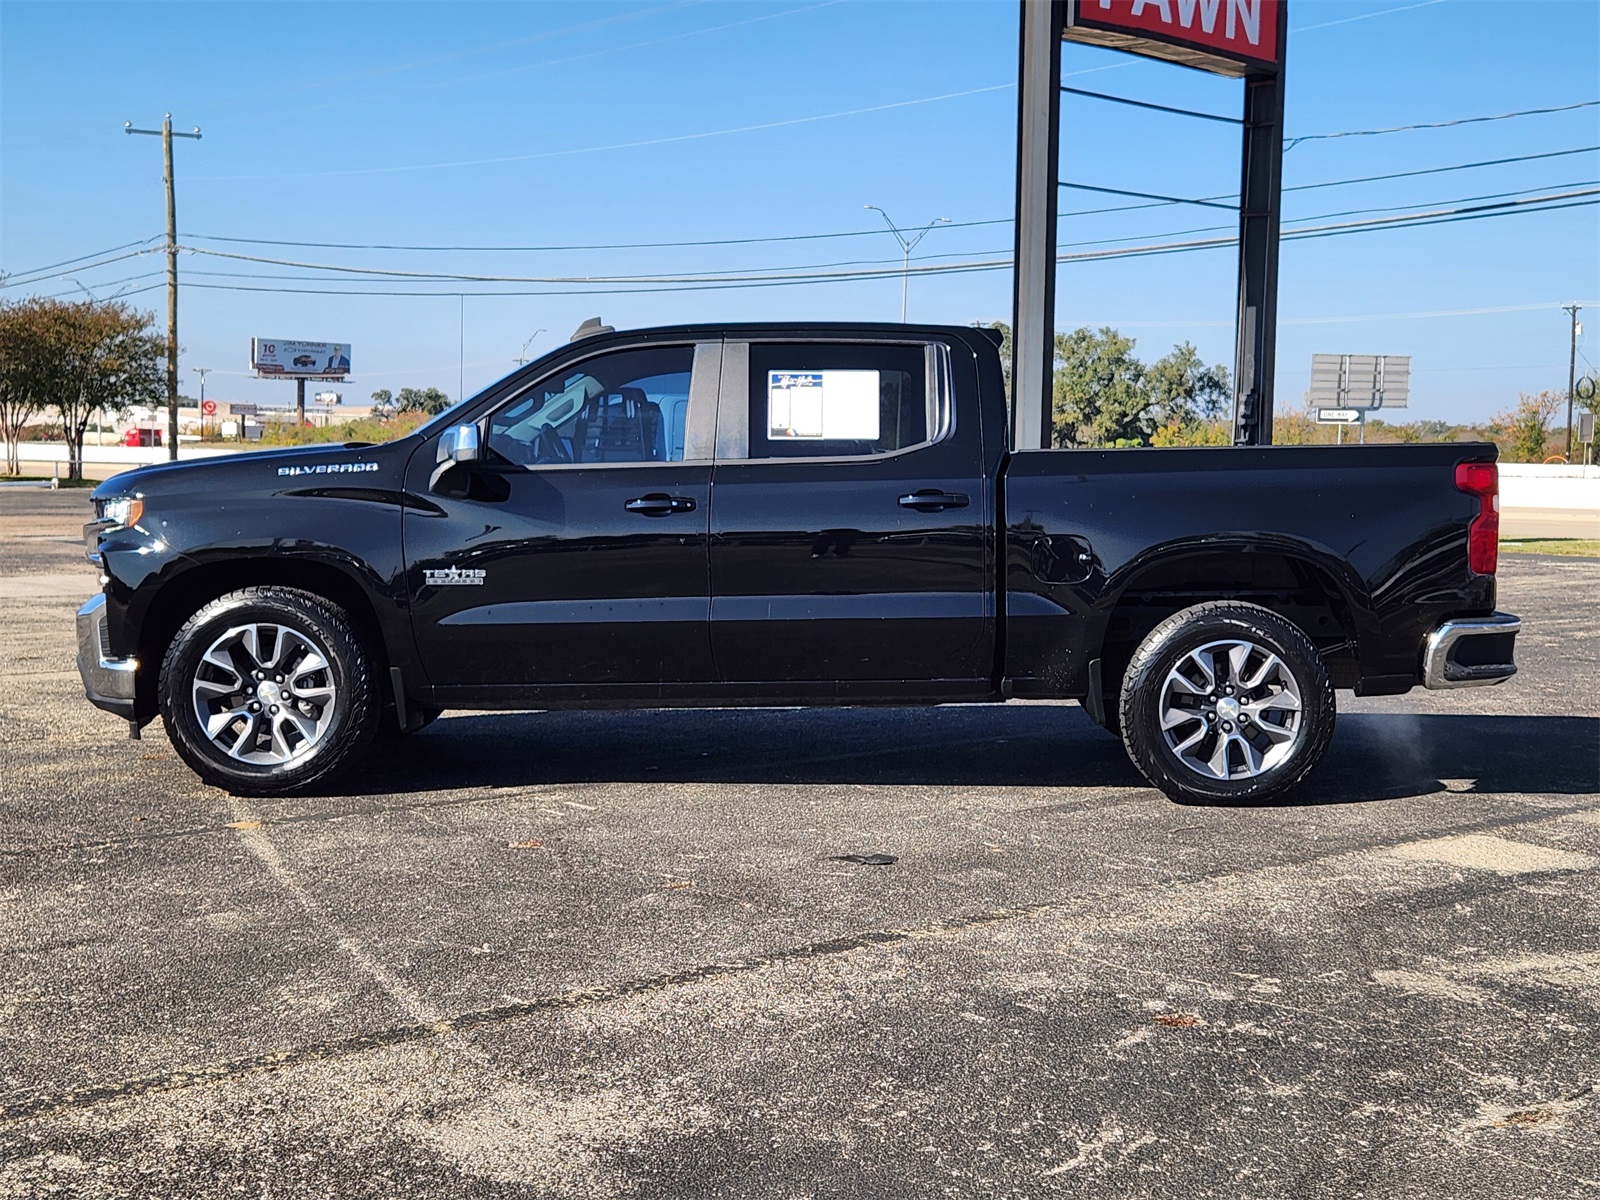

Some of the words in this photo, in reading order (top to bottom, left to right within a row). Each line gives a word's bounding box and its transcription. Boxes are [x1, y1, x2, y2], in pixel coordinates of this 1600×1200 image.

[1099, 0, 1260, 46] WN
[263, 344, 276, 354] 10
[278, 463, 379, 476] SILVERADO
[423, 565, 486, 580] TEXAS
